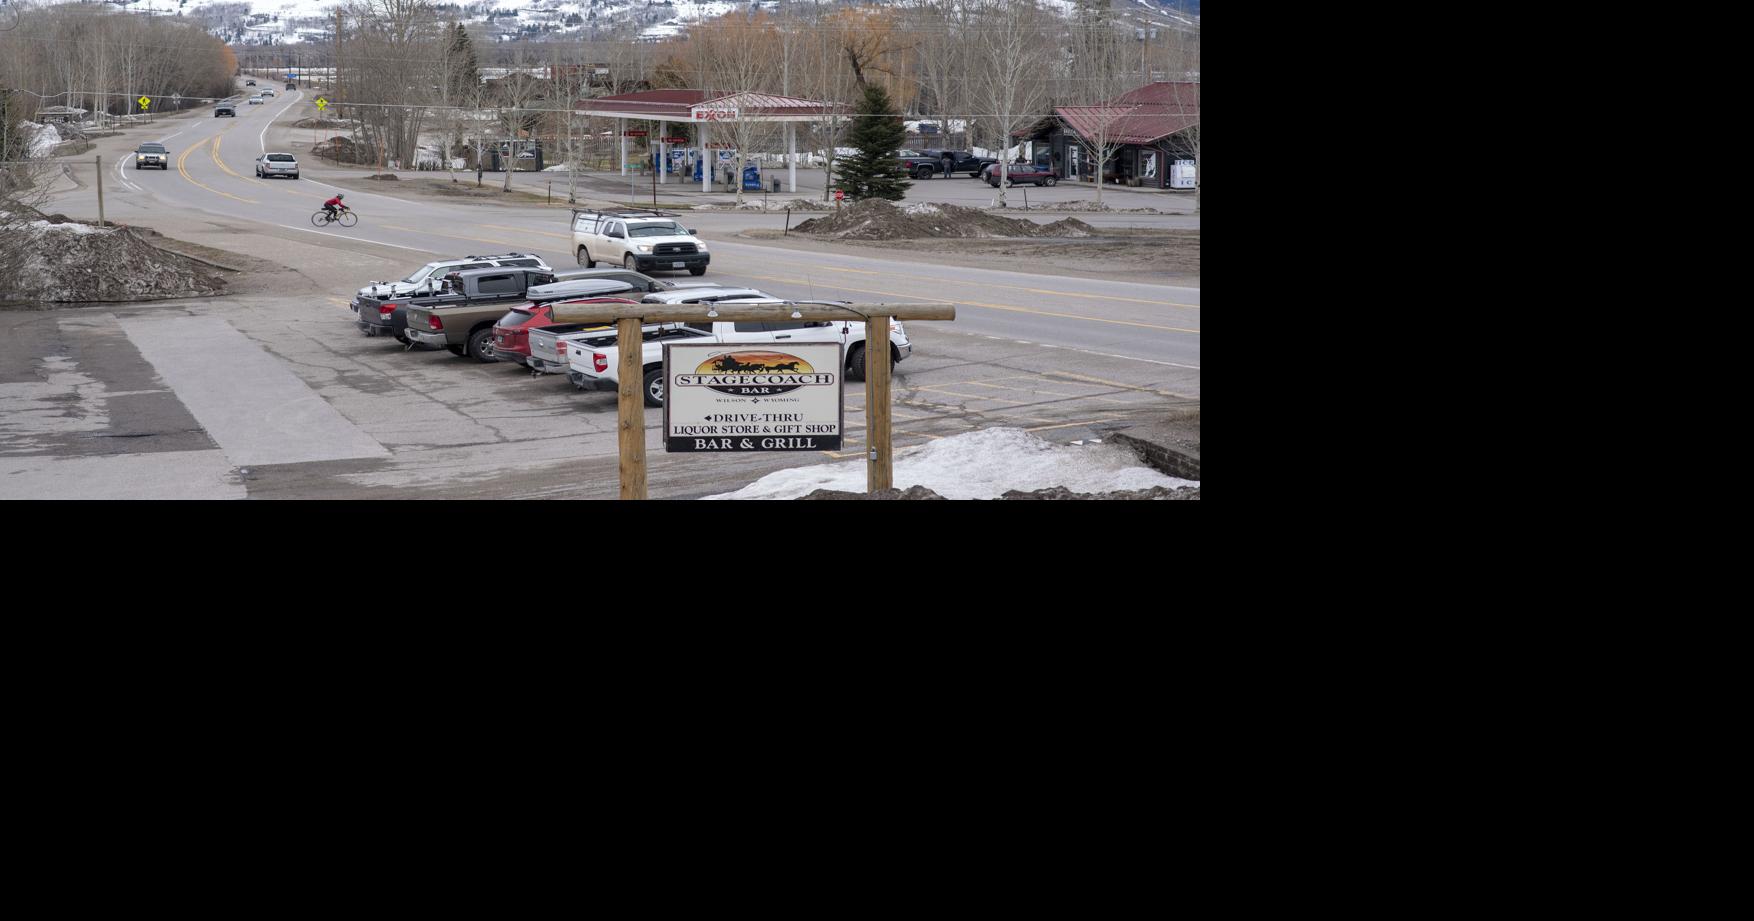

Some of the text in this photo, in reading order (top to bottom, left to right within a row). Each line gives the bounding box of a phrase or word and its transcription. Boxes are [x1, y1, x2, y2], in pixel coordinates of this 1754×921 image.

[695, 110, 736, 120] EXXON
[680, 375, 829, 384] STAGECOACH
[713, 413, 803, 422] DRIVE-THRU
[674, 426, 718, 435] LIQUOR
[721, 425, 760, 434] STORE
[774, 424, 802, 433] GIFT
[805, 424, 836, 433] SHOP
[694, 437, 817, 449] BAR & GRILL
